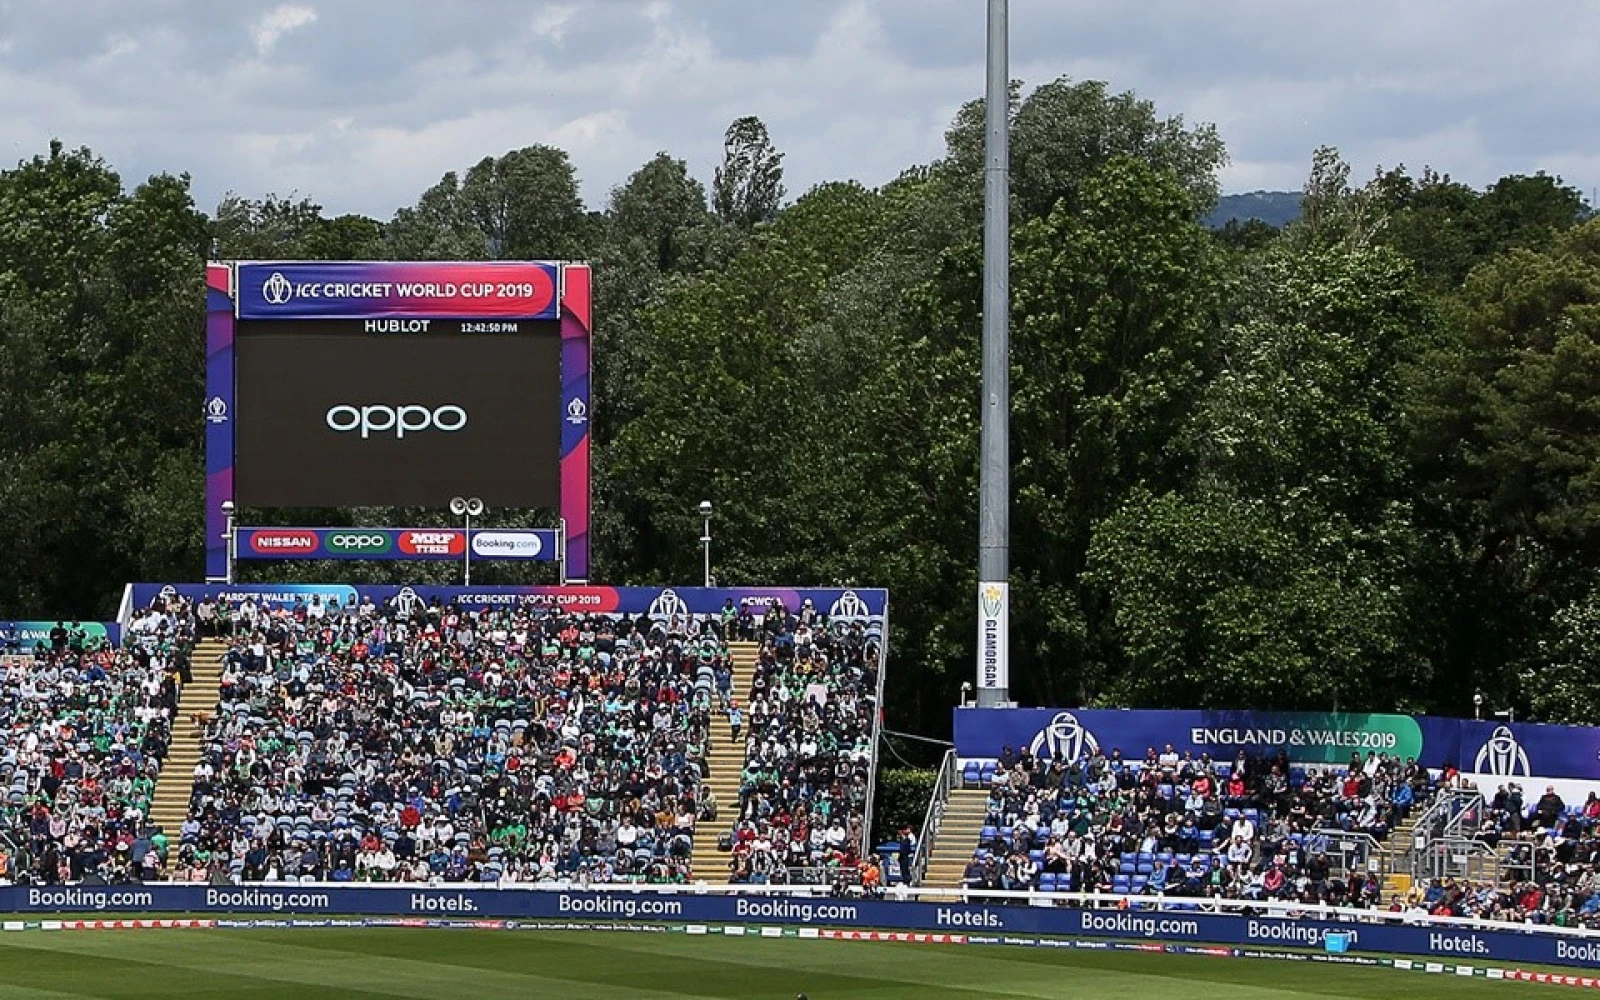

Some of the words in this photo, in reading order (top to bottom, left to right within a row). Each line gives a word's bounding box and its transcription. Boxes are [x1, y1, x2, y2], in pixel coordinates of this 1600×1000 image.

[296, 283, 320, 297] ICC
[323, 283, 392, 297] CRICKET
[397, 283, 456, 297] WORLD
[460, 283, 494, 297] CUP
[497, 283, 533, 297] 2019
[365, 320, 430, 332] HUBLOT
[461, 323, 500, 333] 12:42:50
[502, 323, 518, 333] PM
[327, 405, 467, 438] oppo
[258, 537, 311, 547] NISSAN
[333, 534, 384, 549] oppo
[476, 538, 537, 550] Booking.com
[475, 595, 515, 604] CRICKET
[557, 595, 577, 604] CUP
[579, 595, 601, 604] 2019
[985, 620, 997, 687] GLAMORGAN
[1191, 728, 1286, 745] ENGLAND
[1289, 729, 1305, 745] &
[1307, 730, 1360, 747] WALES
[1361, 732, 1396, 748] 2019
[30, 888, 152, 911] Booking.com
[207, 888, 328, 911] Booking.com
[411, 894, 477, 912] Hotels.
[560, 894, 680, 915] Booking.com
[737, 898, 856, 919] Booking.com
[938, 908, 1003, 927] Hotels.
[1082, 913, 1197, 936] Booking.com
[1430, 933, 1489, 954] Hotels.
